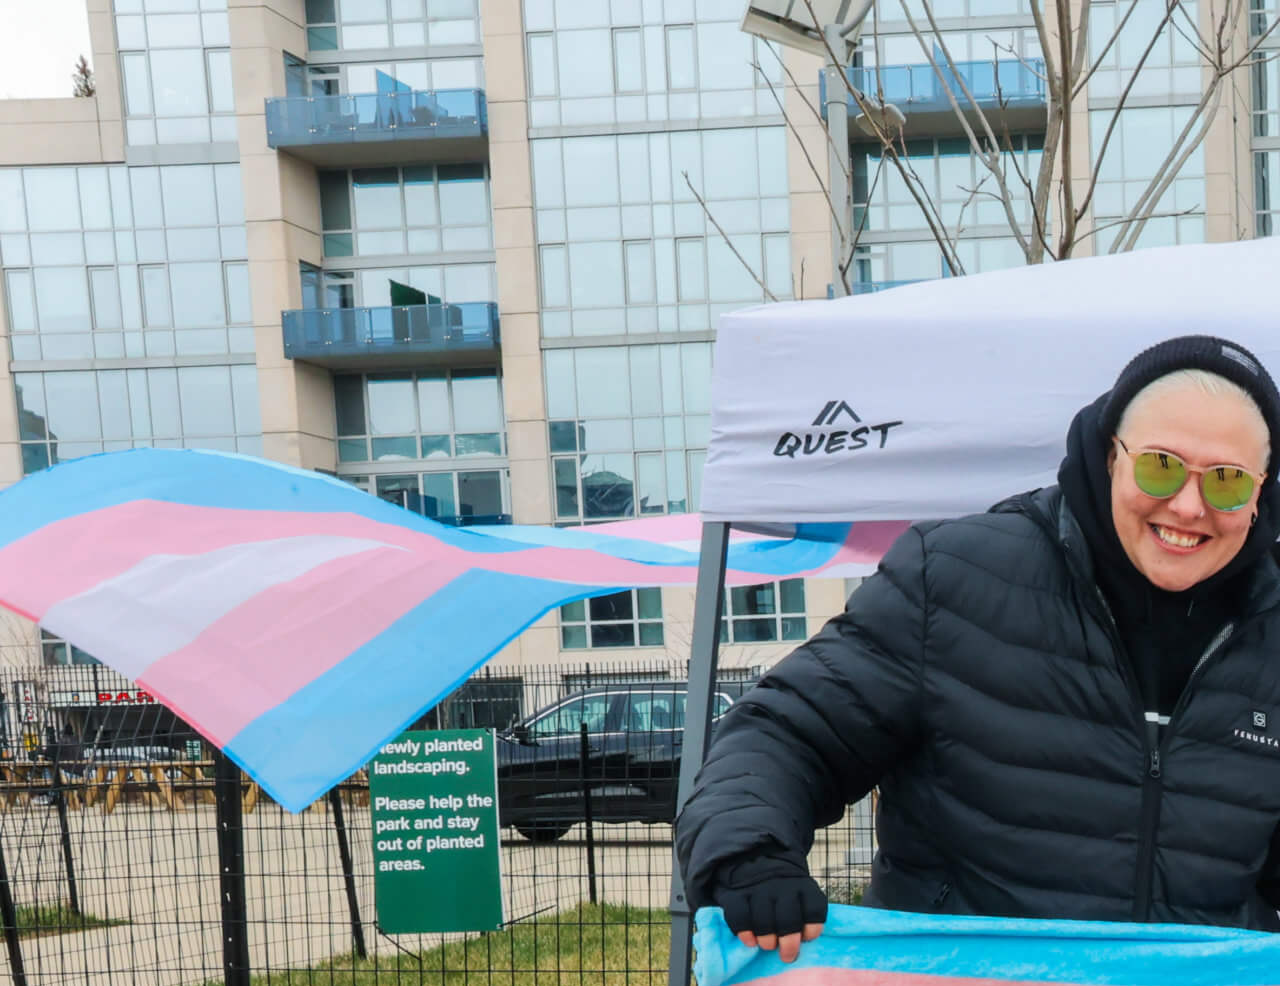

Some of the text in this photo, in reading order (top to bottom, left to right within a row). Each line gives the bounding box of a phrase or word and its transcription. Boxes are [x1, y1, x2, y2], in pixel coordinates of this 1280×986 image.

[773, 420, 903, 458] QUEST
[425, 737, 483, 756] planted
[374, 759, 470, 776] landscaping.
[375, 793, 493, 811] Please help the
[376, 815, 480, 834] park and stay
[377, 834, 484, 853] out of planted
[379, 859, 425, 871] areas.
